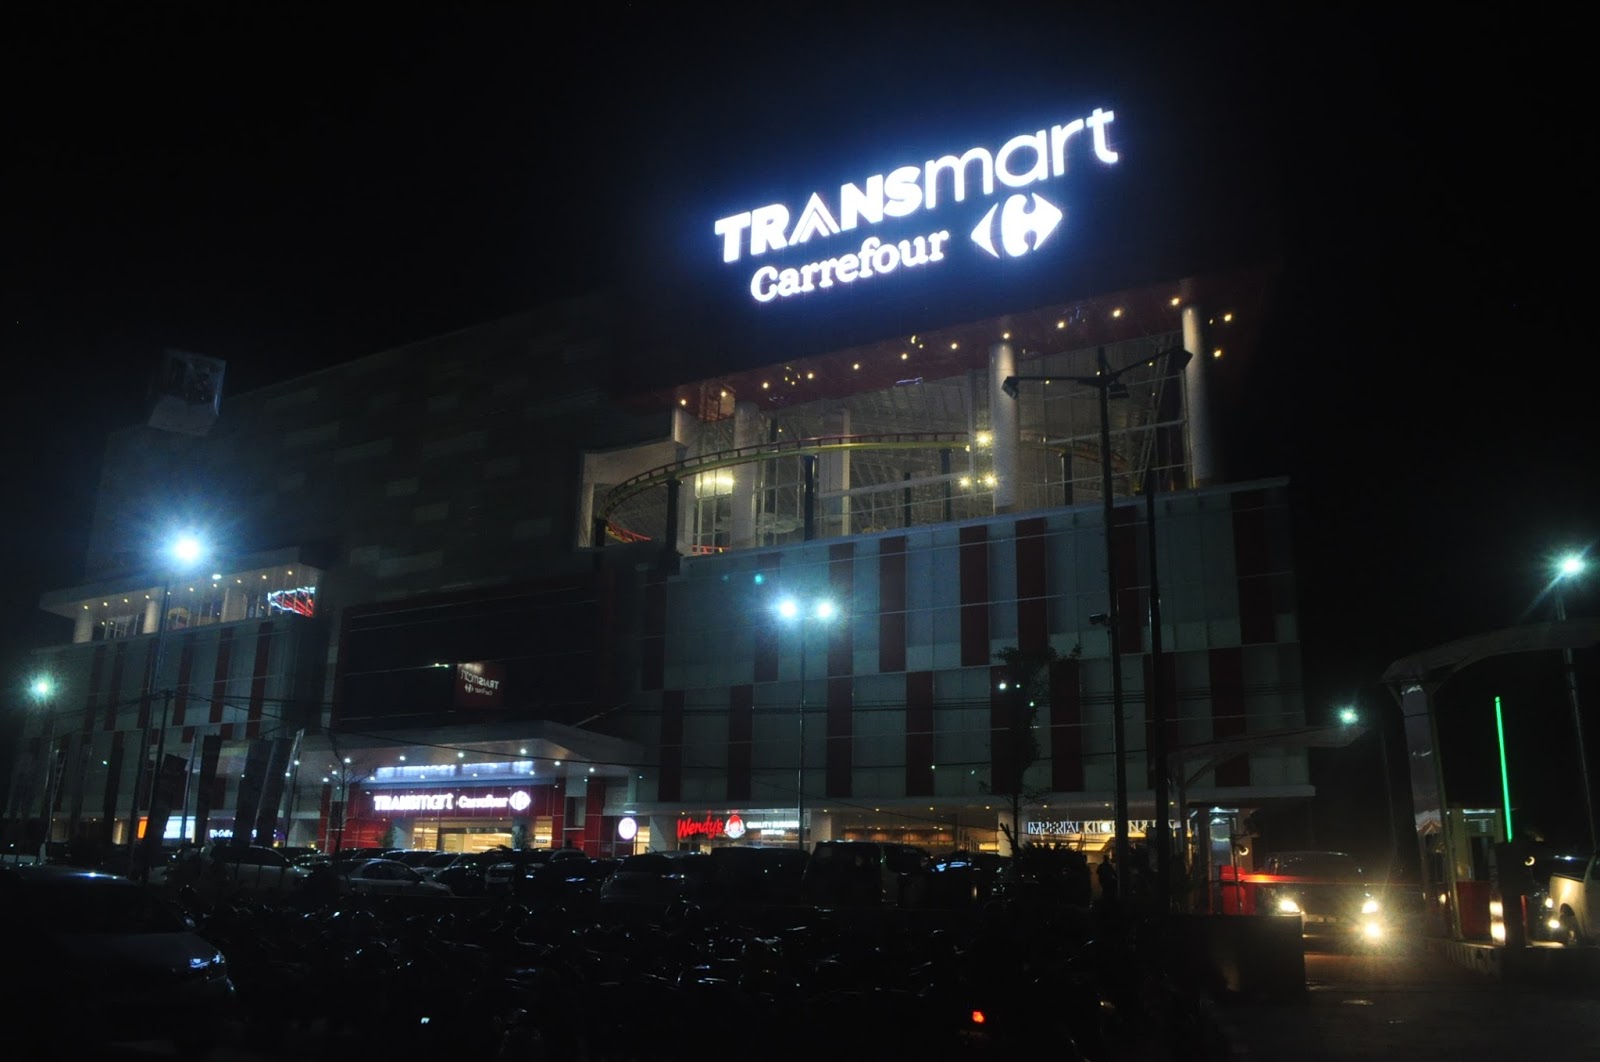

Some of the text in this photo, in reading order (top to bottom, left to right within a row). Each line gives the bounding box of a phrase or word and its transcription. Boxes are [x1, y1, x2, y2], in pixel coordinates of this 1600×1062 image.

[714, 107, 1119, 263] TRANSmart
[750, 229, 949, 302] Carrefour
[677, 814, 724, 839] Wendy's
